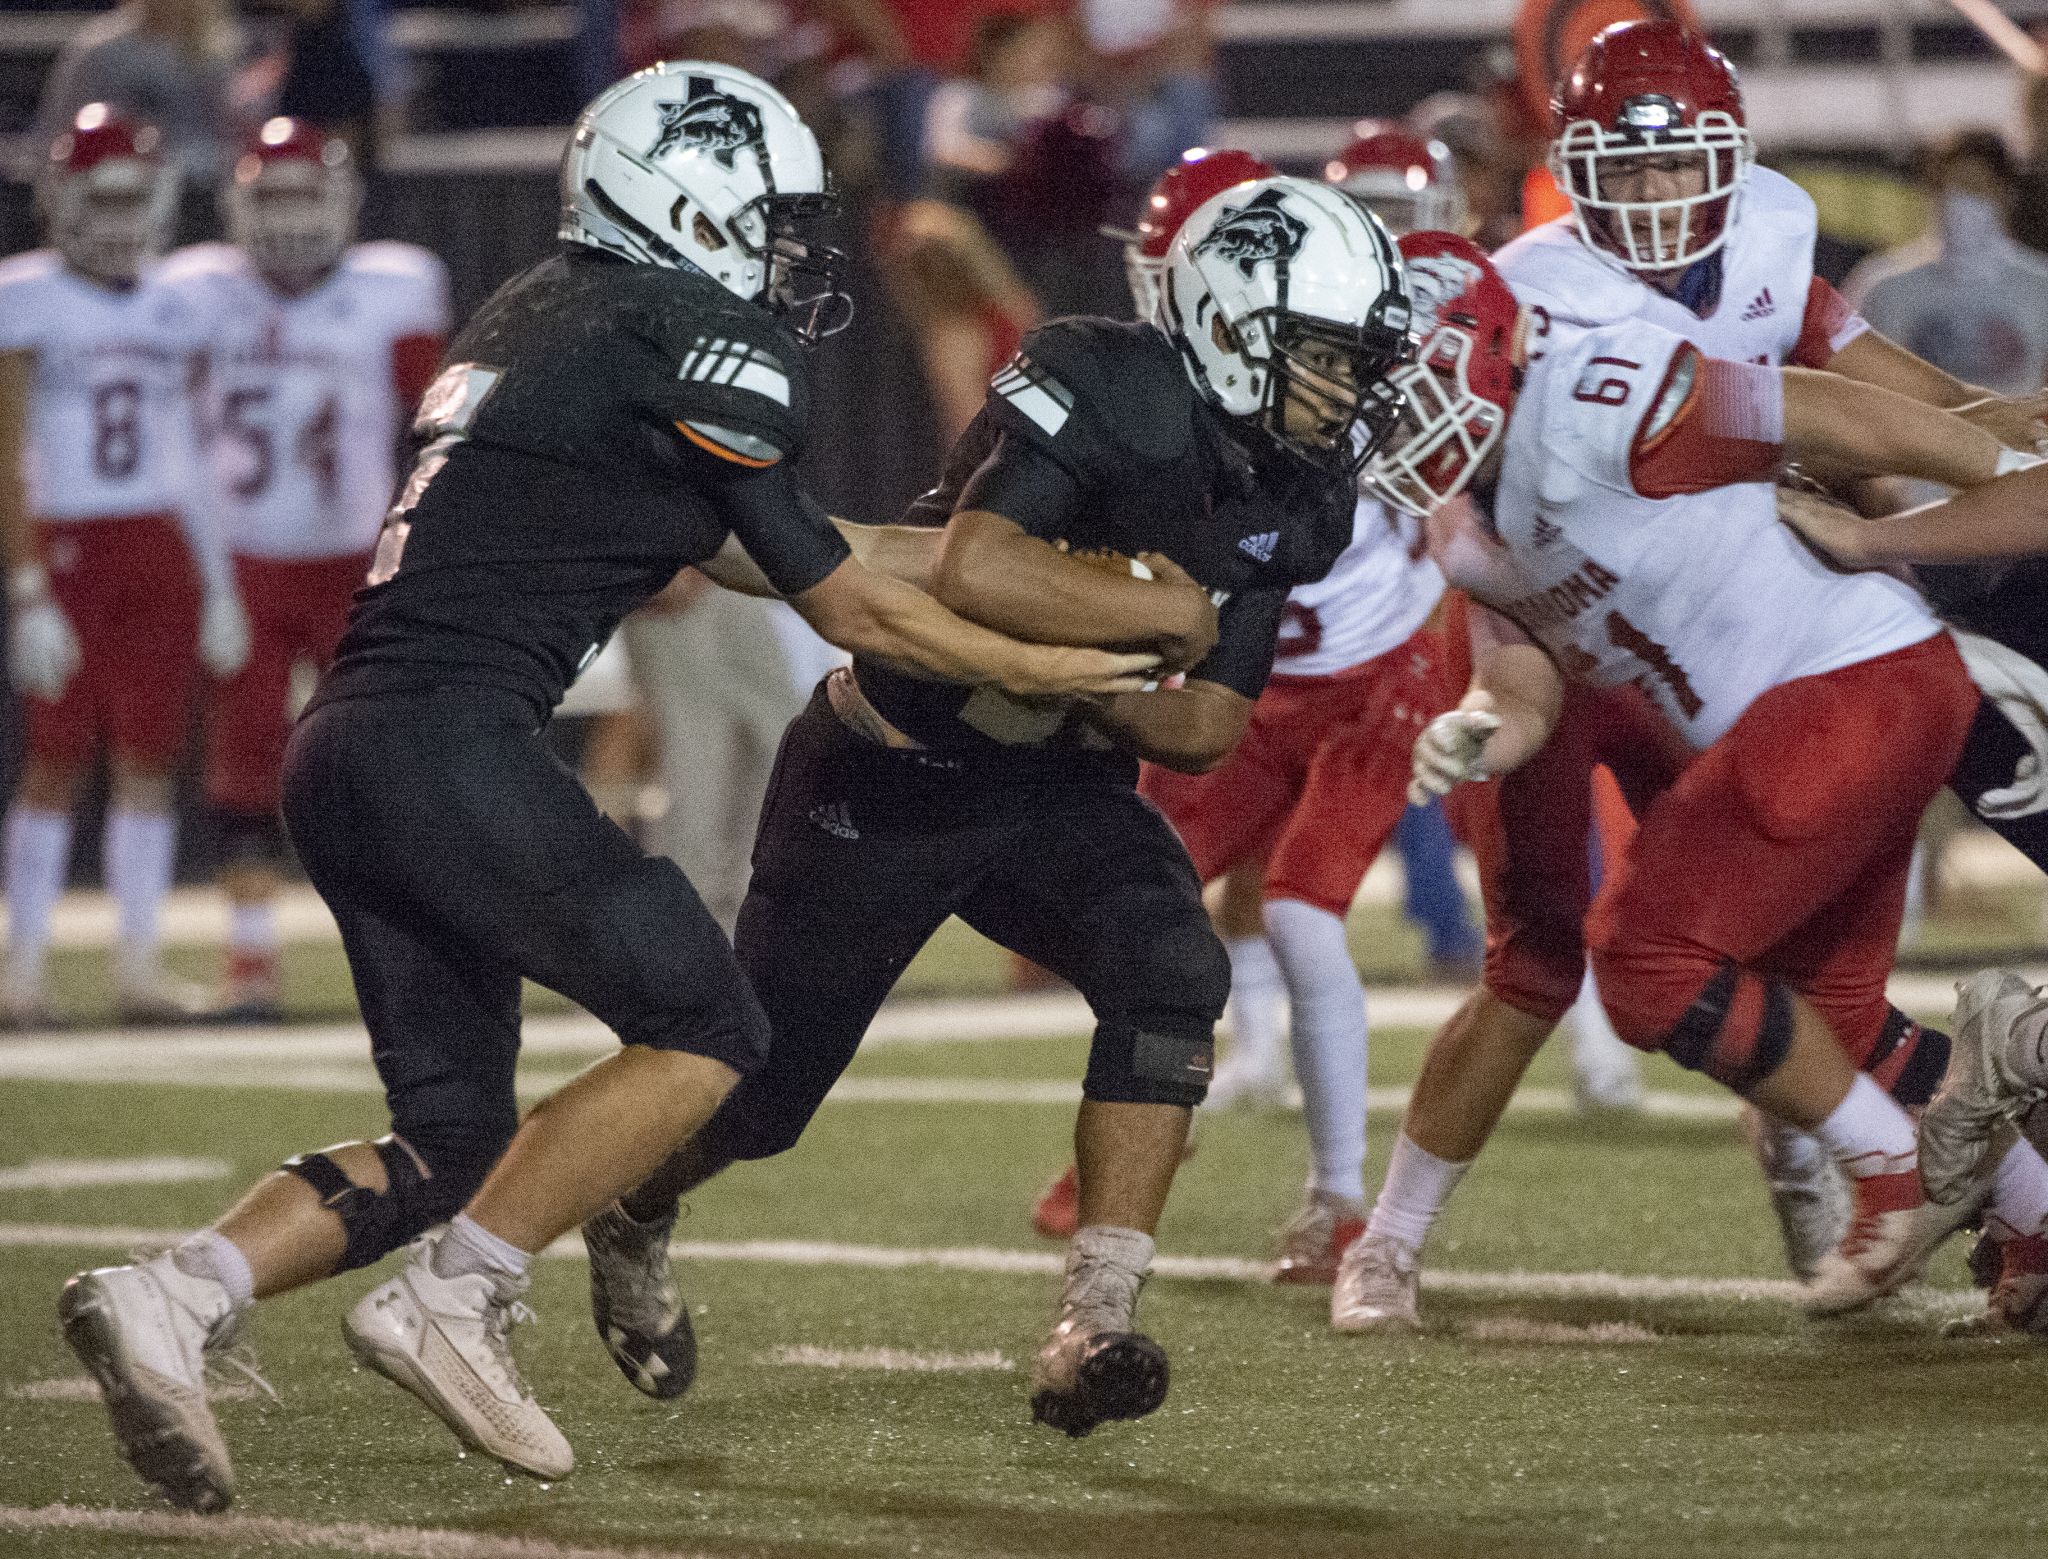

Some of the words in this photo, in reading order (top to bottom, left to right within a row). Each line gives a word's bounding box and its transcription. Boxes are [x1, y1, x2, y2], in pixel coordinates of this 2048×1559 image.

[95, 379, 142, 480] 8
[1573, 357, 1641, 406] 61
[220, 386, 340, 506] 54
